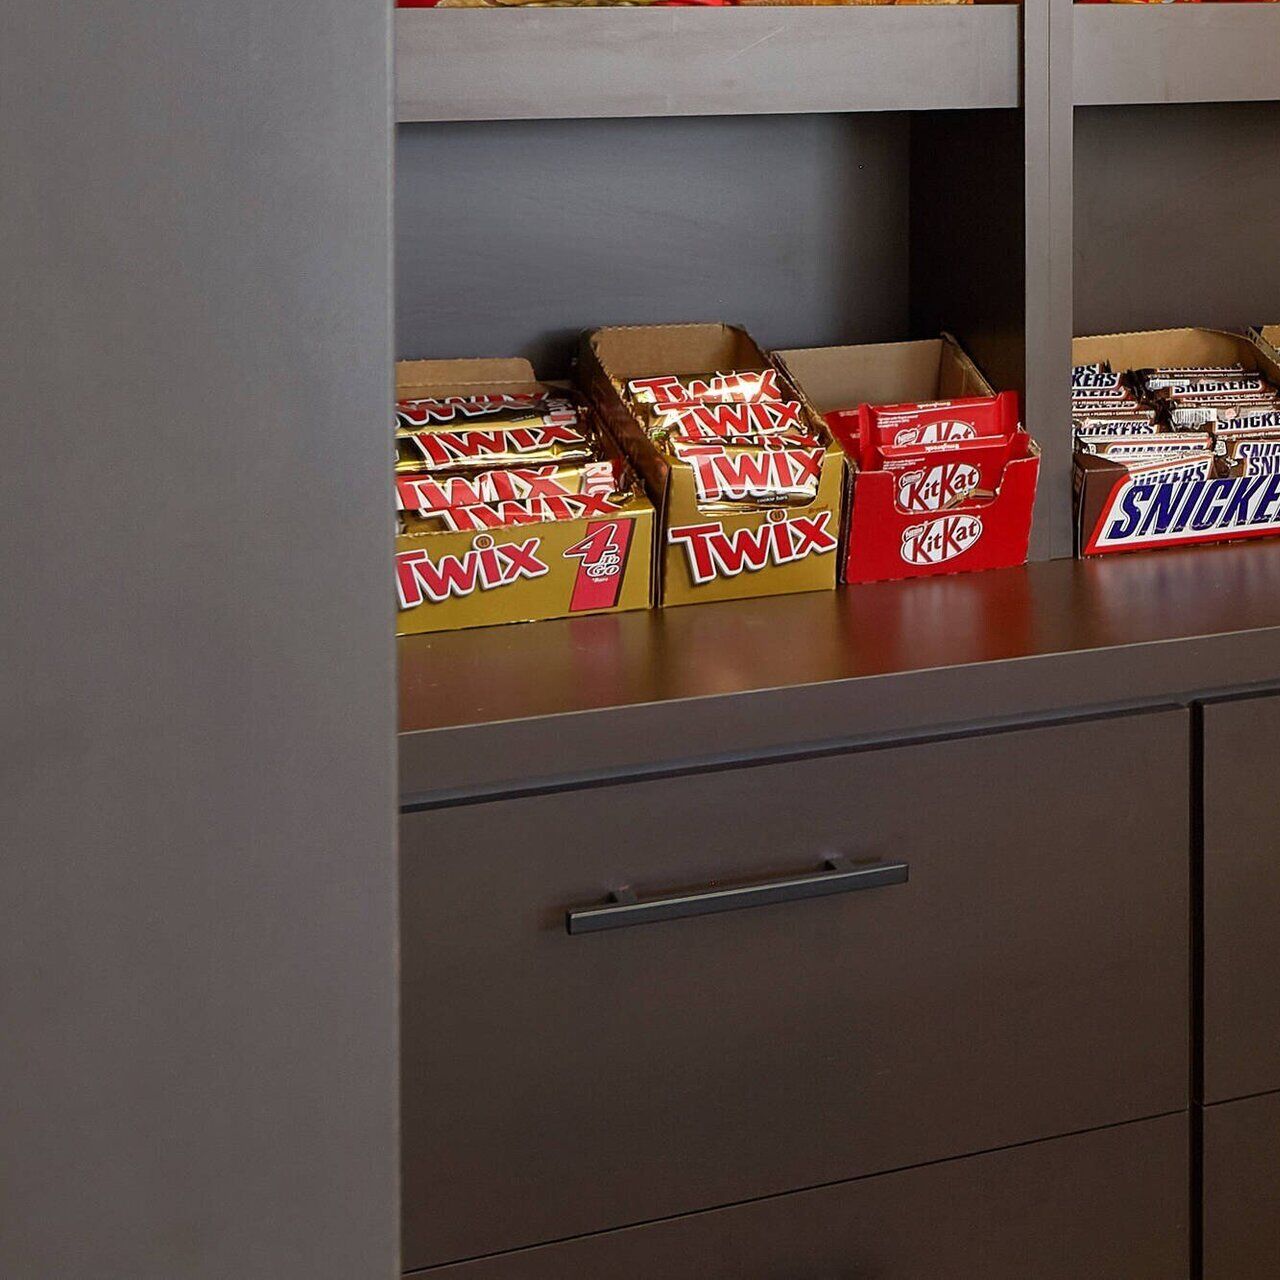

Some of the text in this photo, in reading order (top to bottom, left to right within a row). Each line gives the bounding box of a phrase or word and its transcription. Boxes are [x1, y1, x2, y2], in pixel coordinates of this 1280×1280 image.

[630, 369, 783, 404] TWIX
[654, 400, 802, 437] TWIX
[678, 447, 827, 500] TWIX
[907, 463, 978, 511] KitKat
[563, 524, 619, 568] 4
[668, 509, 838, 584] TWIX
[911, 515, 978, 563] KitKat
[396, 533, 551, 610] TWIX
